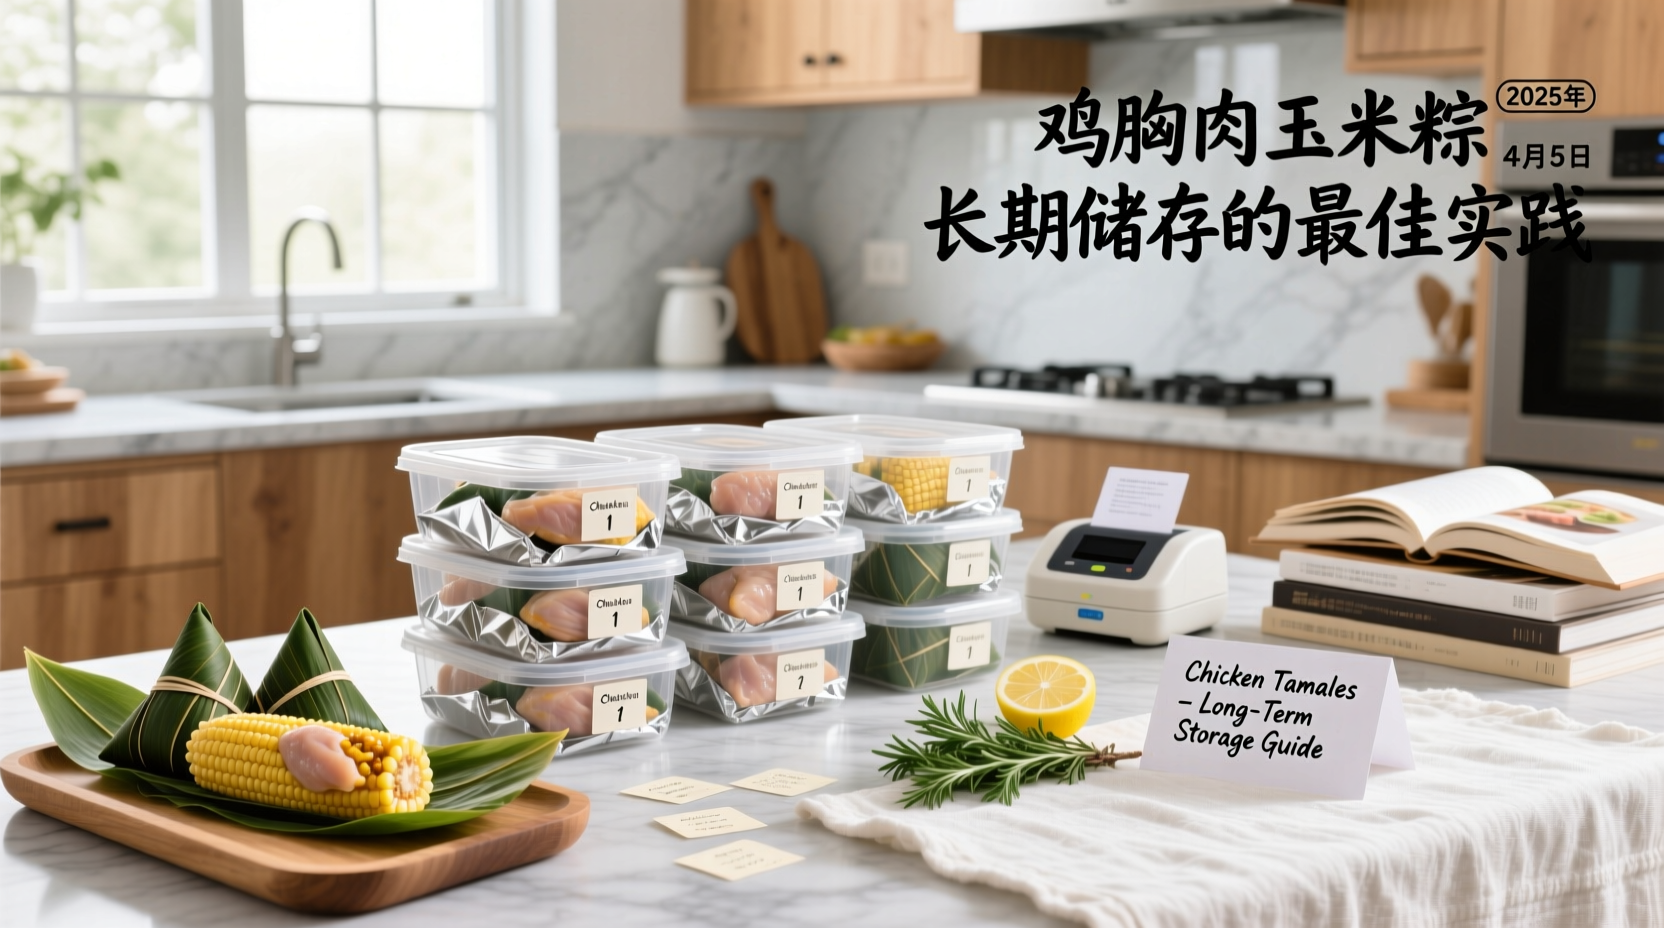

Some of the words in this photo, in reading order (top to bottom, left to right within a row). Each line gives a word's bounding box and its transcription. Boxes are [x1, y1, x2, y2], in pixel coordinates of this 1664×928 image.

[797, 494, 803, 510] 1
[606, 513, 613, 532] 1
[797, 586, 803, 602] 1
[612, 611, 619, 628] 1
[1185, 659, 1265, 689] Chicken
[1273, 669, 1358, 700] Tamales
[617, 705, 624, 723] 1
[1198, 691, 1313, 728] Long-Term
[1173, 718, 1255, 758] Storage
[1261, 730, 1323, 759] Guide
